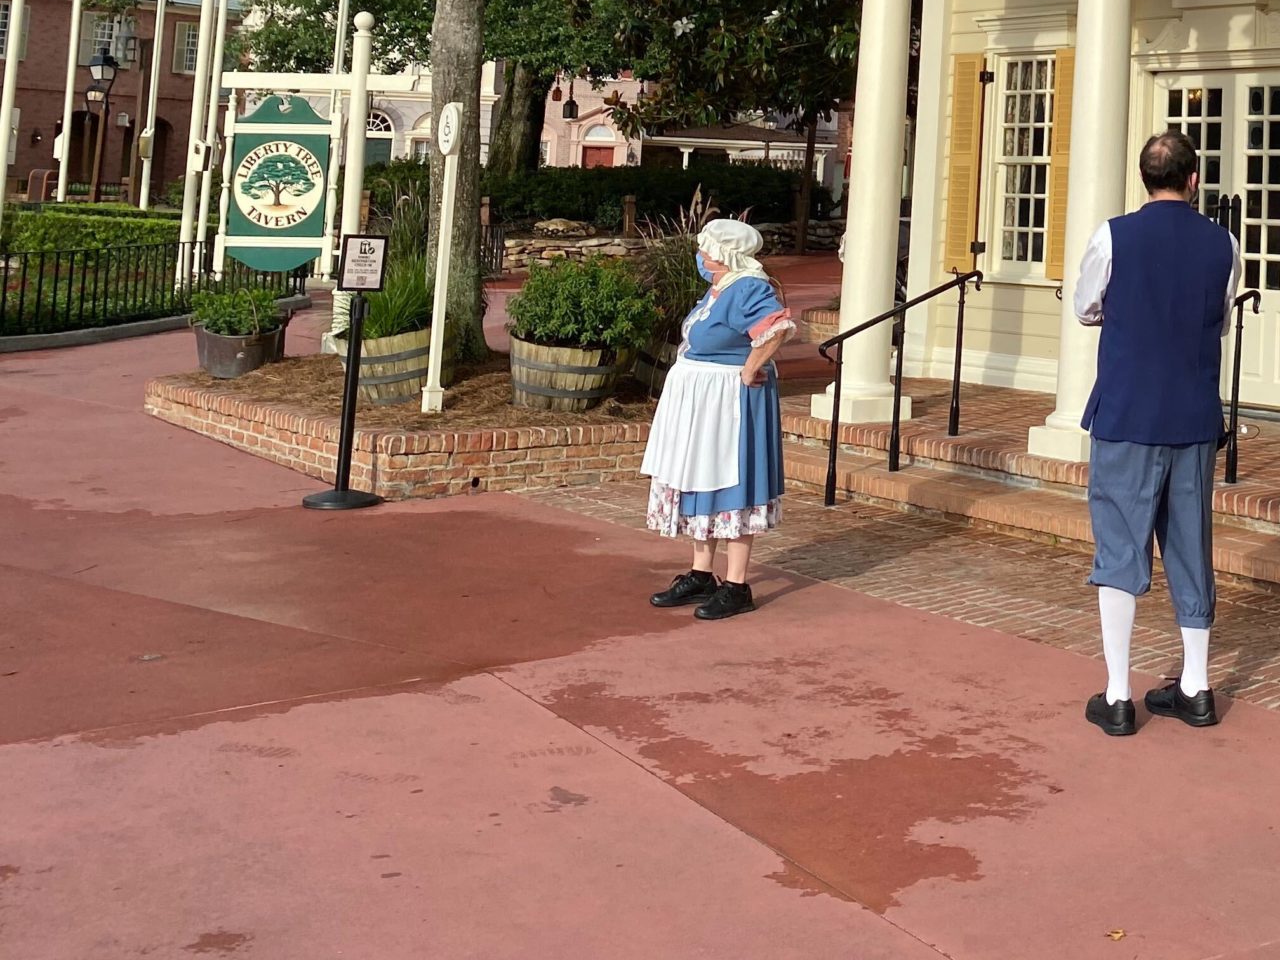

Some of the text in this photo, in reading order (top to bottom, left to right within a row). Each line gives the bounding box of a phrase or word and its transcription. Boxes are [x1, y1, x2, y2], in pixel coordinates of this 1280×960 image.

[237, 142, 322, 180] LIBERTY TREE
[246, 205, 308, 227] TAVERN
